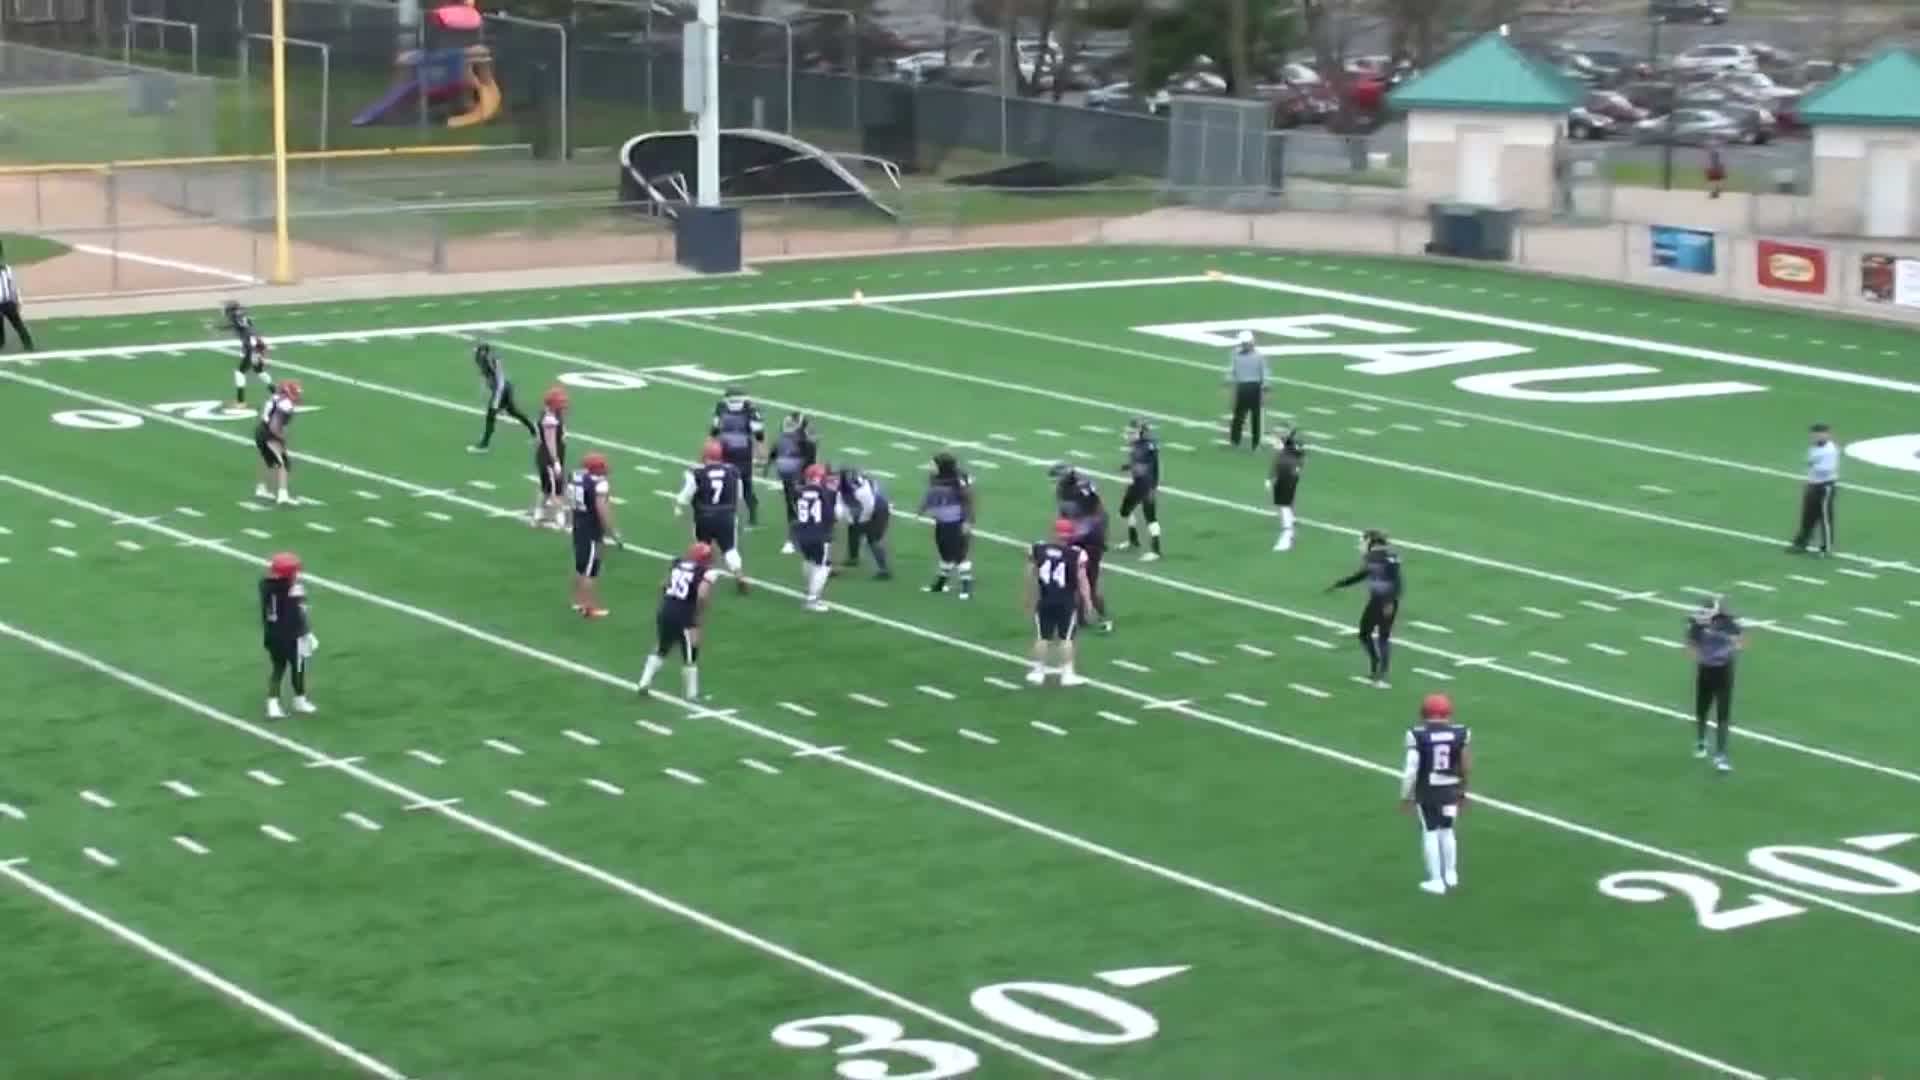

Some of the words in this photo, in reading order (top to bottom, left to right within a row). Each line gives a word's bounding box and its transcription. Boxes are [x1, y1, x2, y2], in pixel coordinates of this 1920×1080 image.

[1128, 313, 1770, 402] EAU
[557, 364, 758, 389] 10
[52, 400, 258, 430] 20
[711, 479, 724, 504] 7
[797, 499, 822, 523] 64
[1039, 559, 1067, 588] 44
[1598, 846, 1920, 930] 20
[771, 981, 1159, 1080] 30
